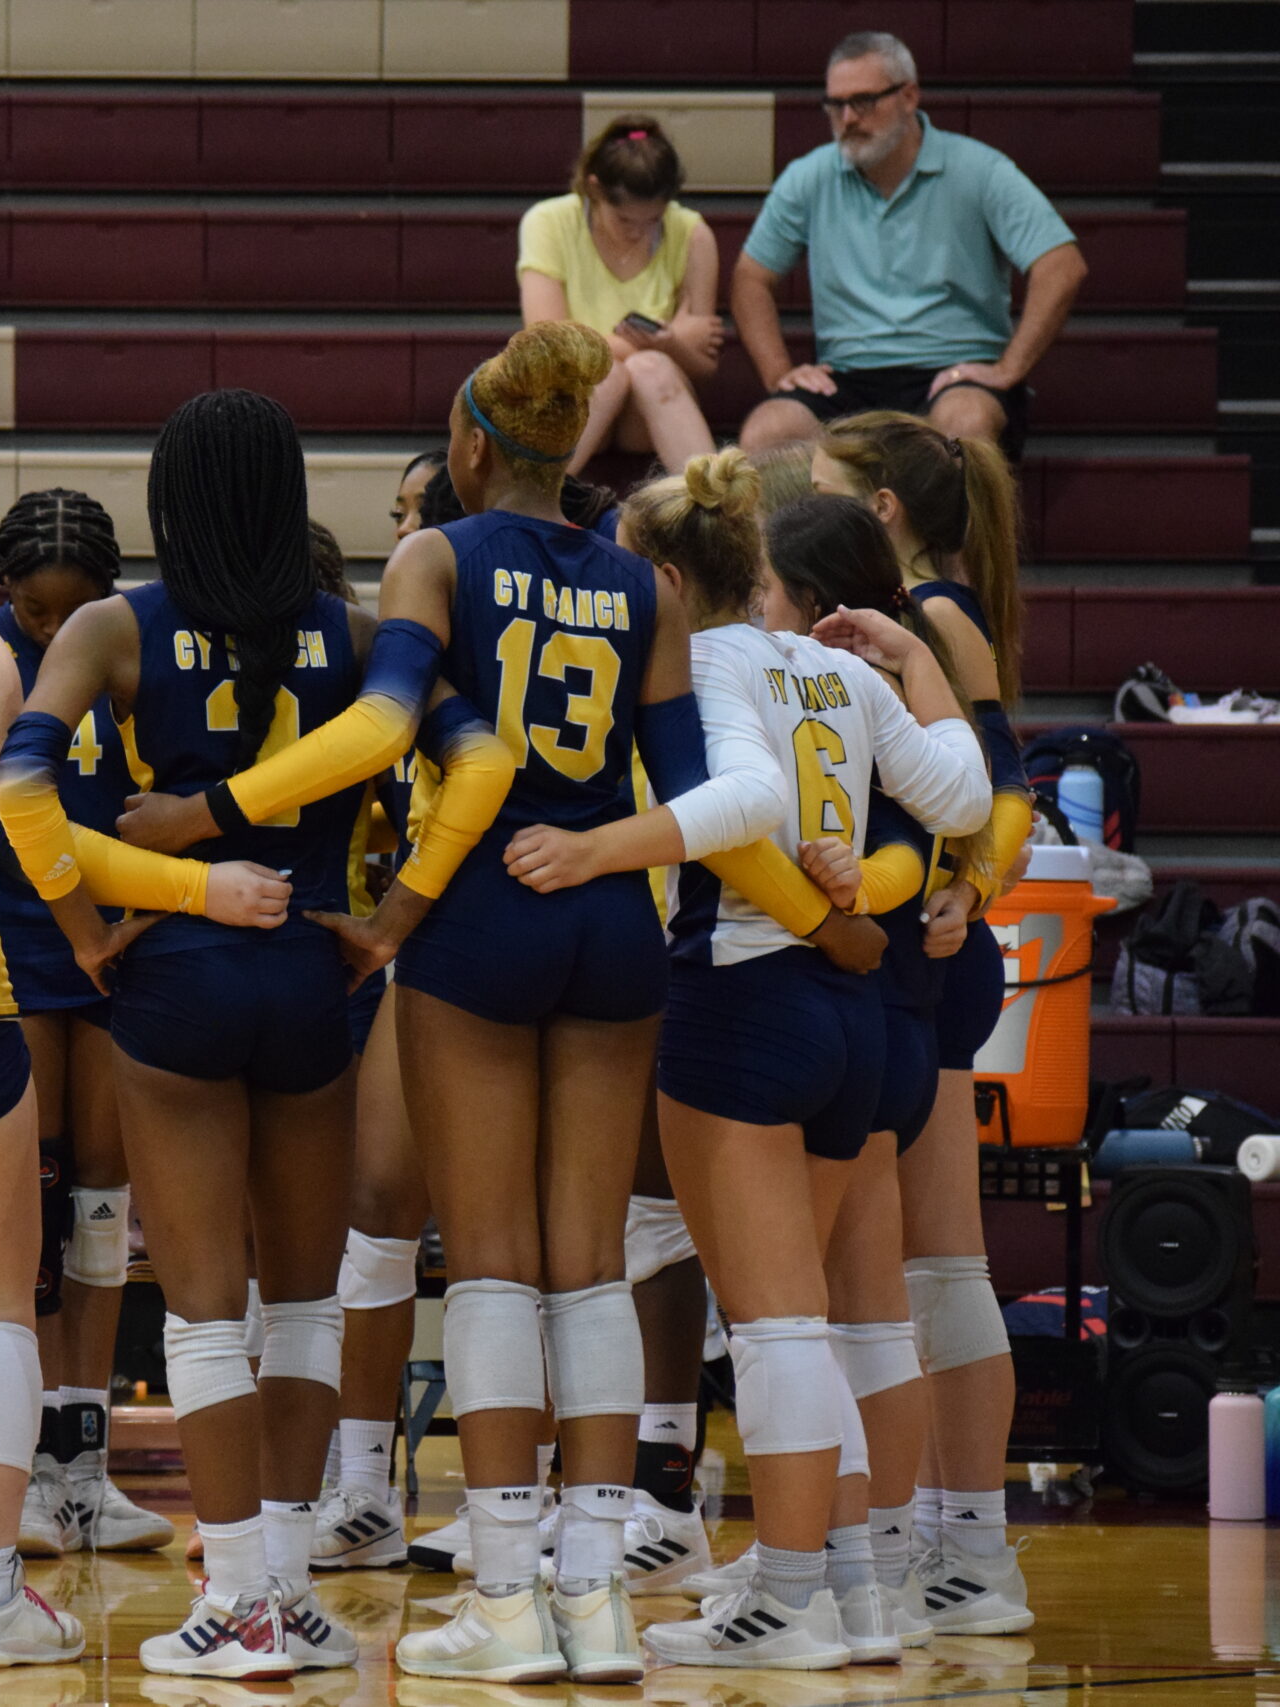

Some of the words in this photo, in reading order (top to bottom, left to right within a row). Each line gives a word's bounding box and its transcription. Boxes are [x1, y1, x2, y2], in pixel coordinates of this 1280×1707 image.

[494, 568, 532, 610] CY
[543, 578, 630, 631] RANCH
[173, 630, 212, 670] CY
[495, 617, 622, 783] 13
[792, 717, 861, 849] 6
[501, 1490, 532, 1501] BYE
[597, 1488, 626, 1500] BYE
